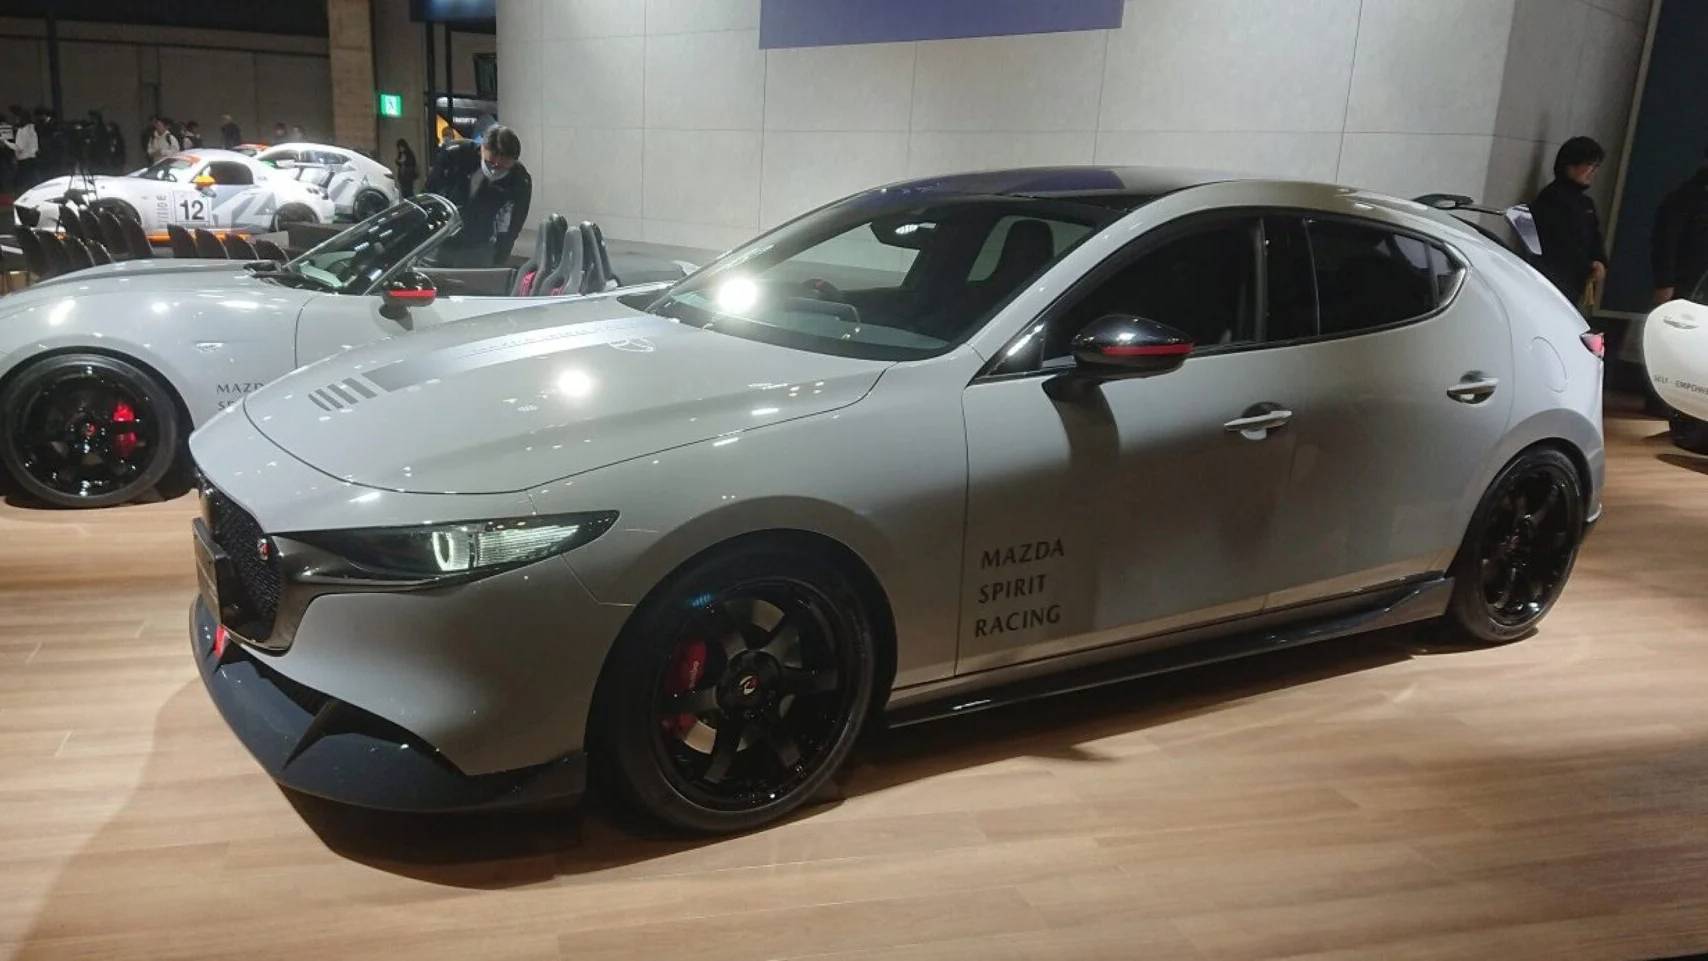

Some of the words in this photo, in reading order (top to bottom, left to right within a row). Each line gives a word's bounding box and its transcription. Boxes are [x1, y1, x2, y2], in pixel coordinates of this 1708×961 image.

[179, 199, 205, 220] 12
[981, 537, 1065, 569] MAZDA
[977, 573, 1047, 604] SPIRIT
[975, 604, 1062, 638] RACING
